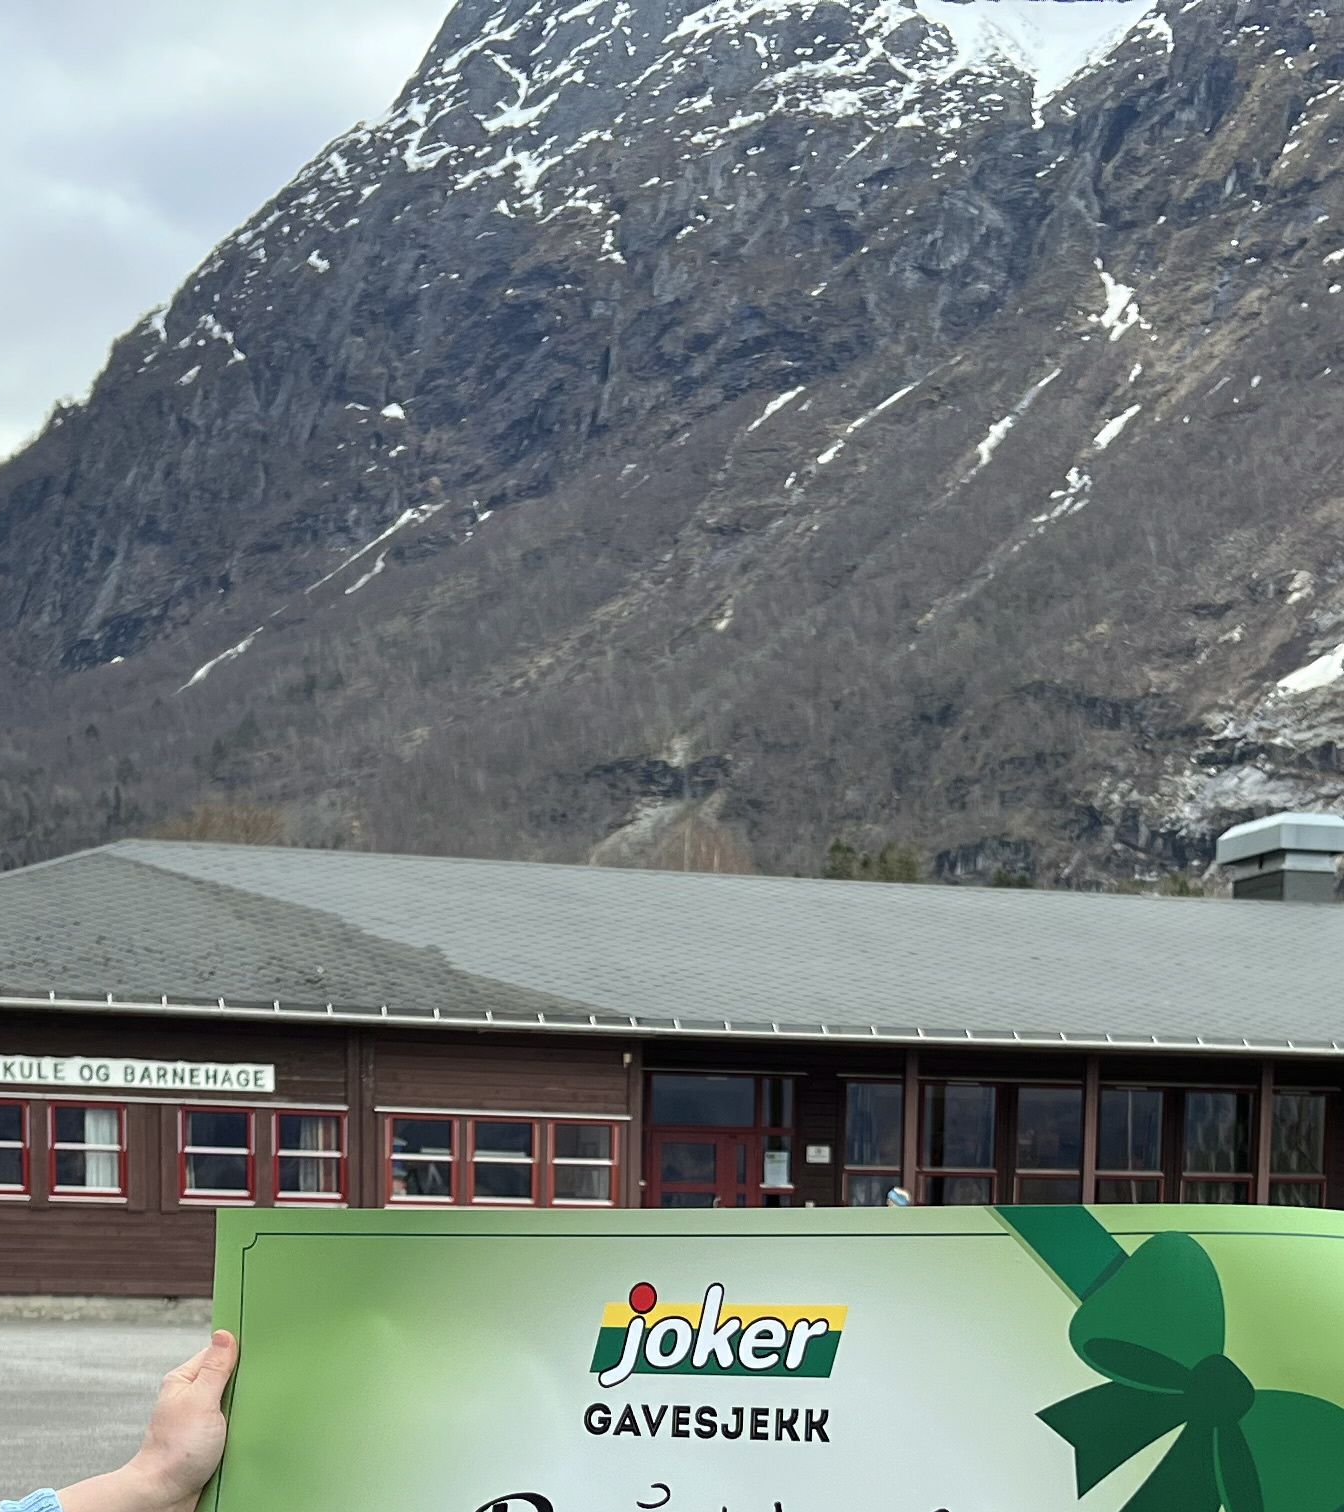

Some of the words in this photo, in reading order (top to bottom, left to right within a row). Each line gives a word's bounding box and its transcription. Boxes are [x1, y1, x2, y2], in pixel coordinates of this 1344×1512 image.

[79, 1064, 110, 1083] OG
[123, 1065, 266, 1088] BARNEHAGE
[598, 1282, 830, 1388] joker
[583, 1402, 830, 1442] GAVESJEKK
